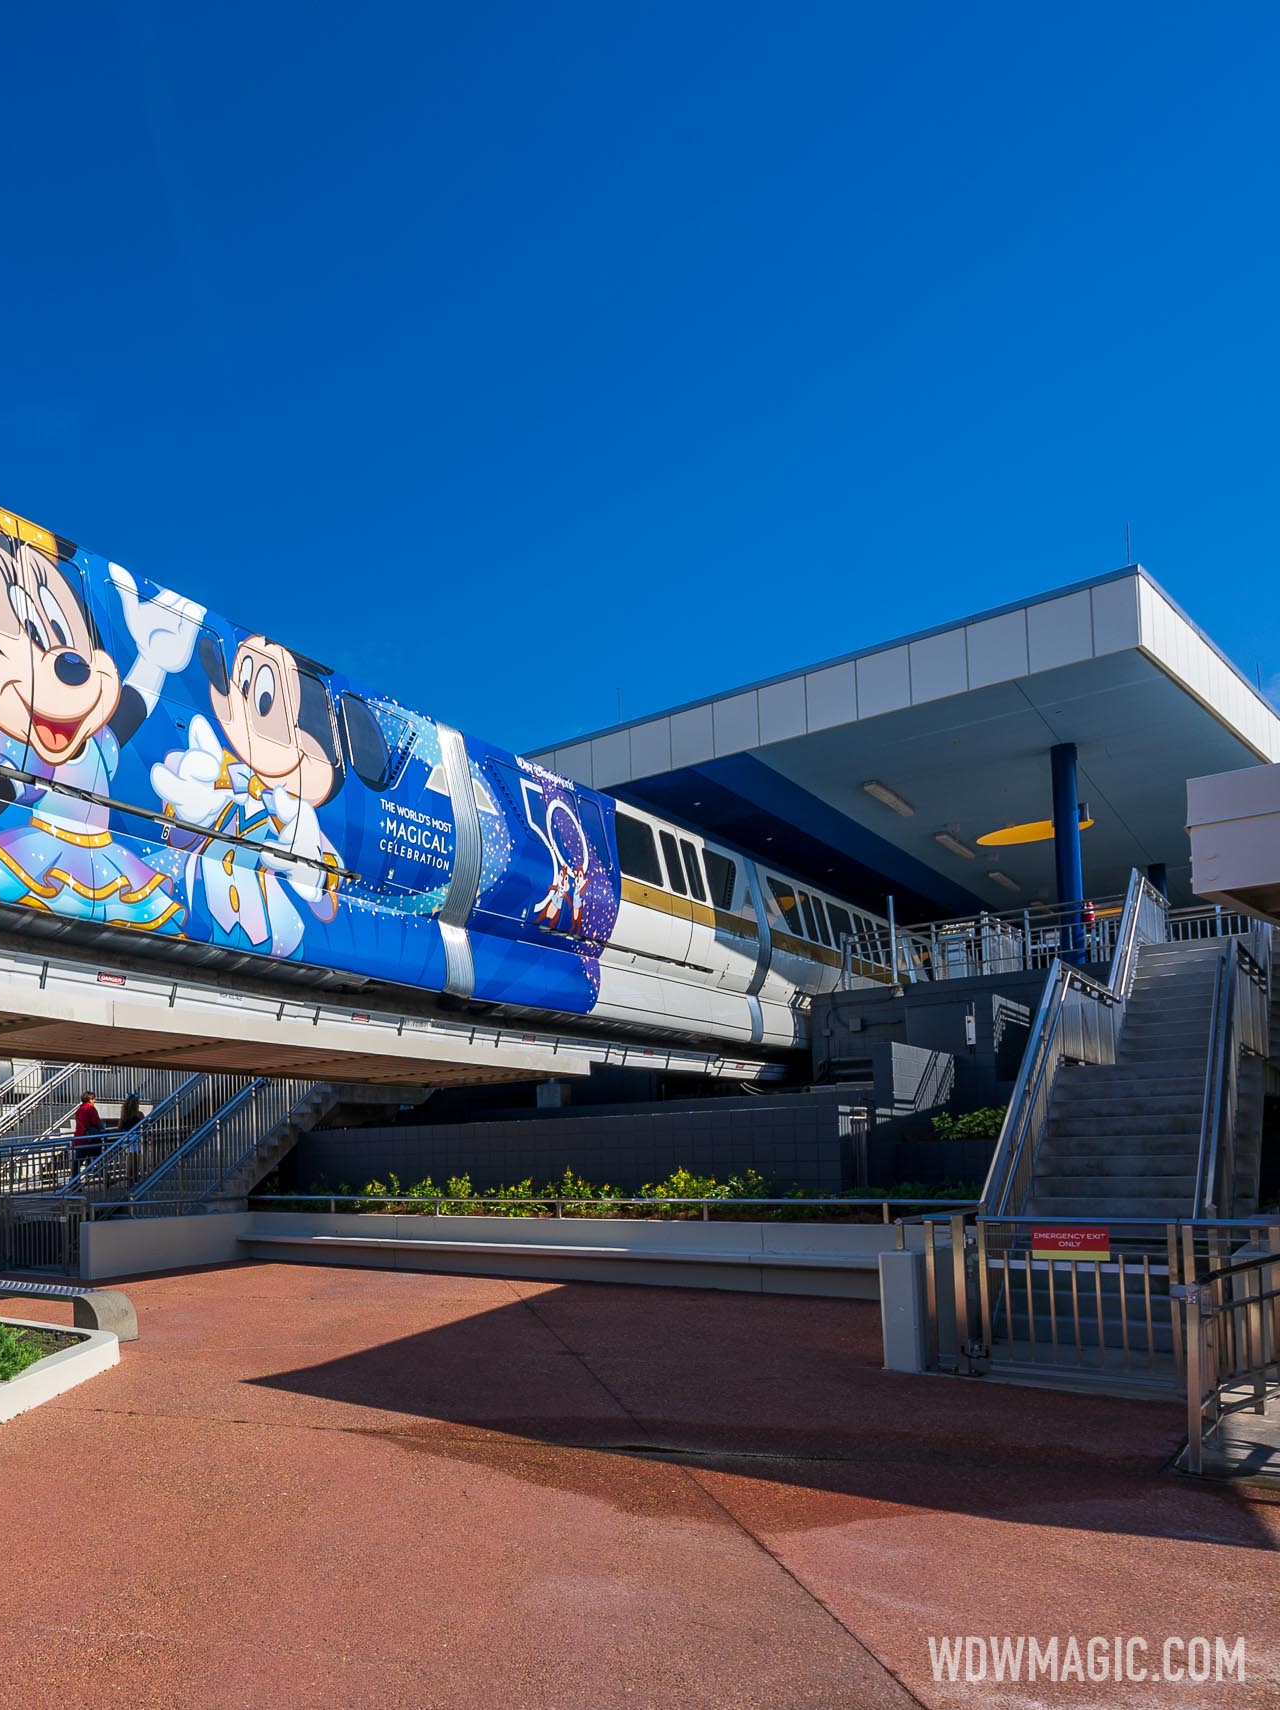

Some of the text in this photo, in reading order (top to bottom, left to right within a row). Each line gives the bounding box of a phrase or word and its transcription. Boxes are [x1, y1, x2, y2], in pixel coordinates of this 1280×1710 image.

[380, 798, 452, 834] THE WORLD'S MOST
[163, 826, 169, 838] 6
[386, 816, 448, 855] MAGICAL
[379, 838, 450, 871] CELEBRATION
[1033, 1232, 1105, 1240] EMERGENCY EXIT
[1058, 1240, 1081, 1248] ONLY
